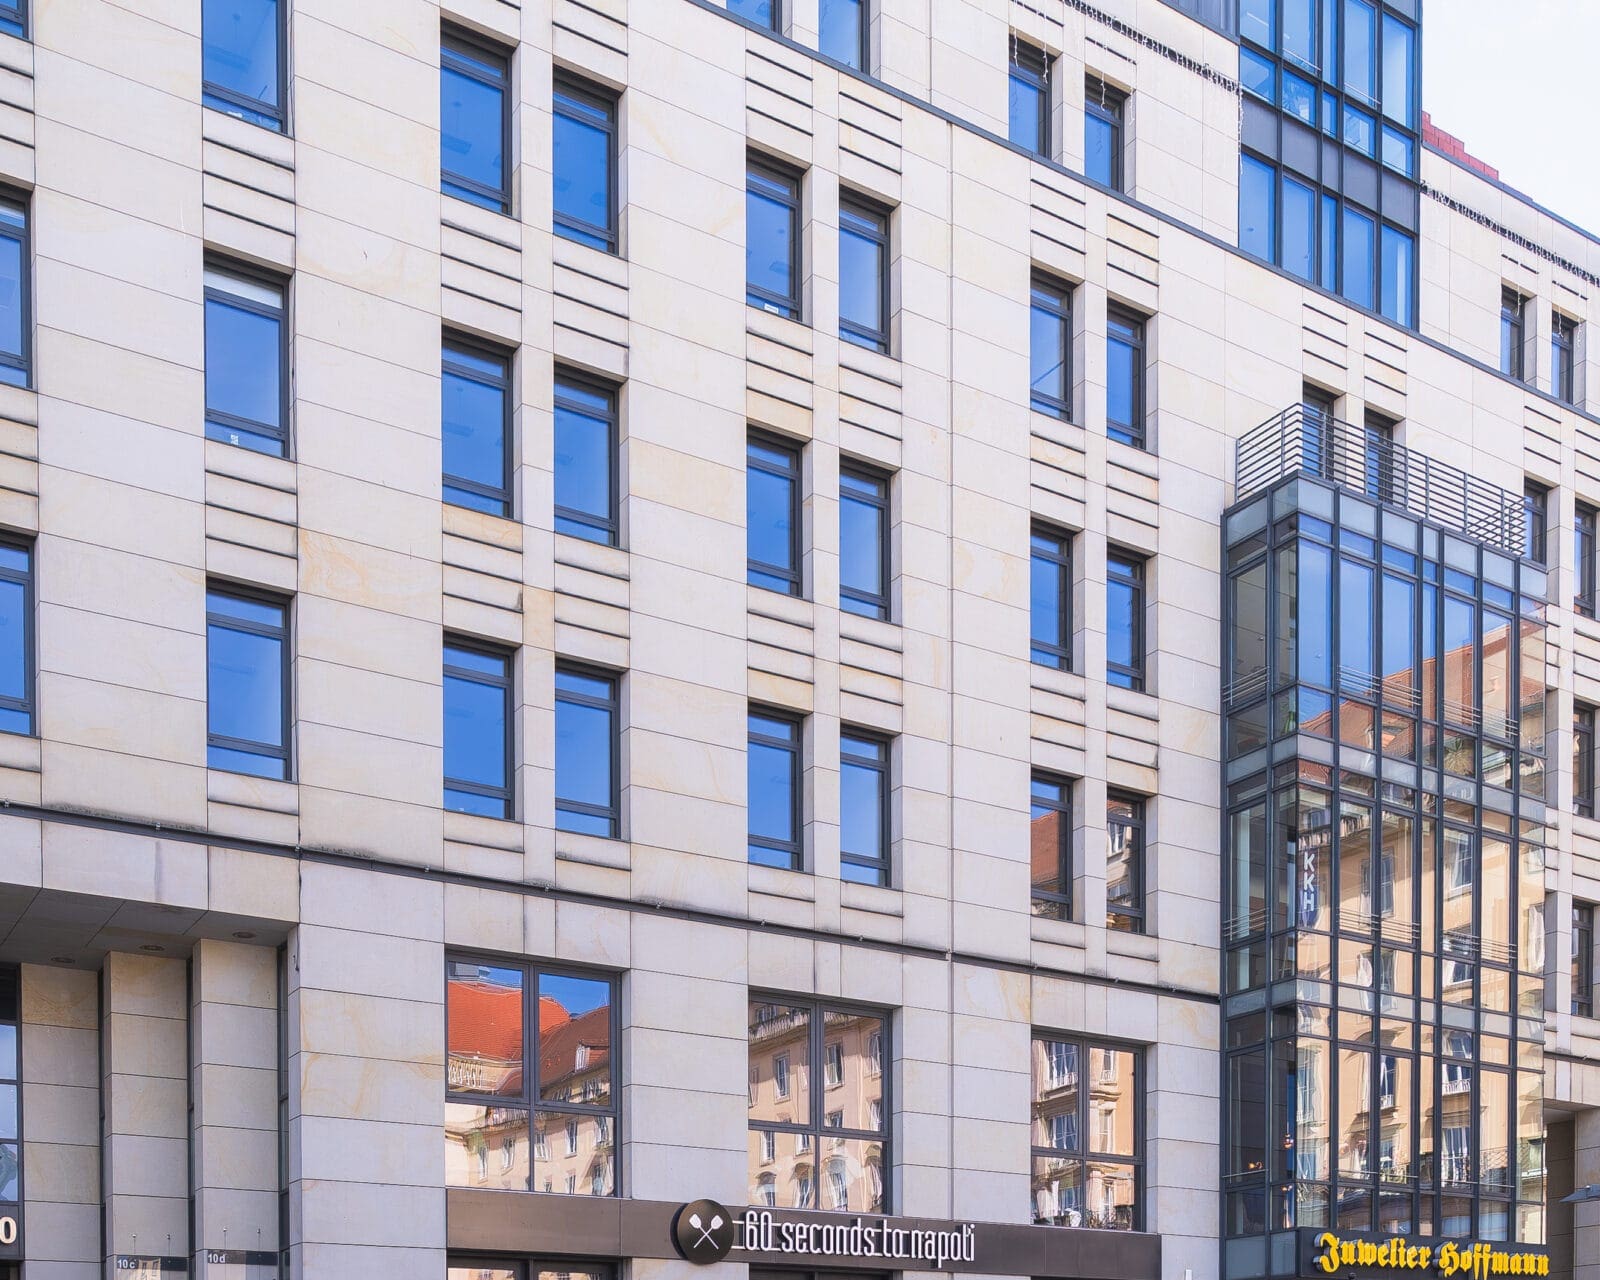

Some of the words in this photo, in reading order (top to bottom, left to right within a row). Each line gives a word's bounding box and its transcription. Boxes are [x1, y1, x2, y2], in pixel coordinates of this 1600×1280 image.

[1303, 851, 1315, 911] KKH
[744, 1210, 773, 1252] 60
[781, 1216, 875, 1257] seconds
[882, 1220, 903, 1259] to
[911, 1223, 975, 1268] napoli
[1319, 1232, 1432, 1273] Juwelier
